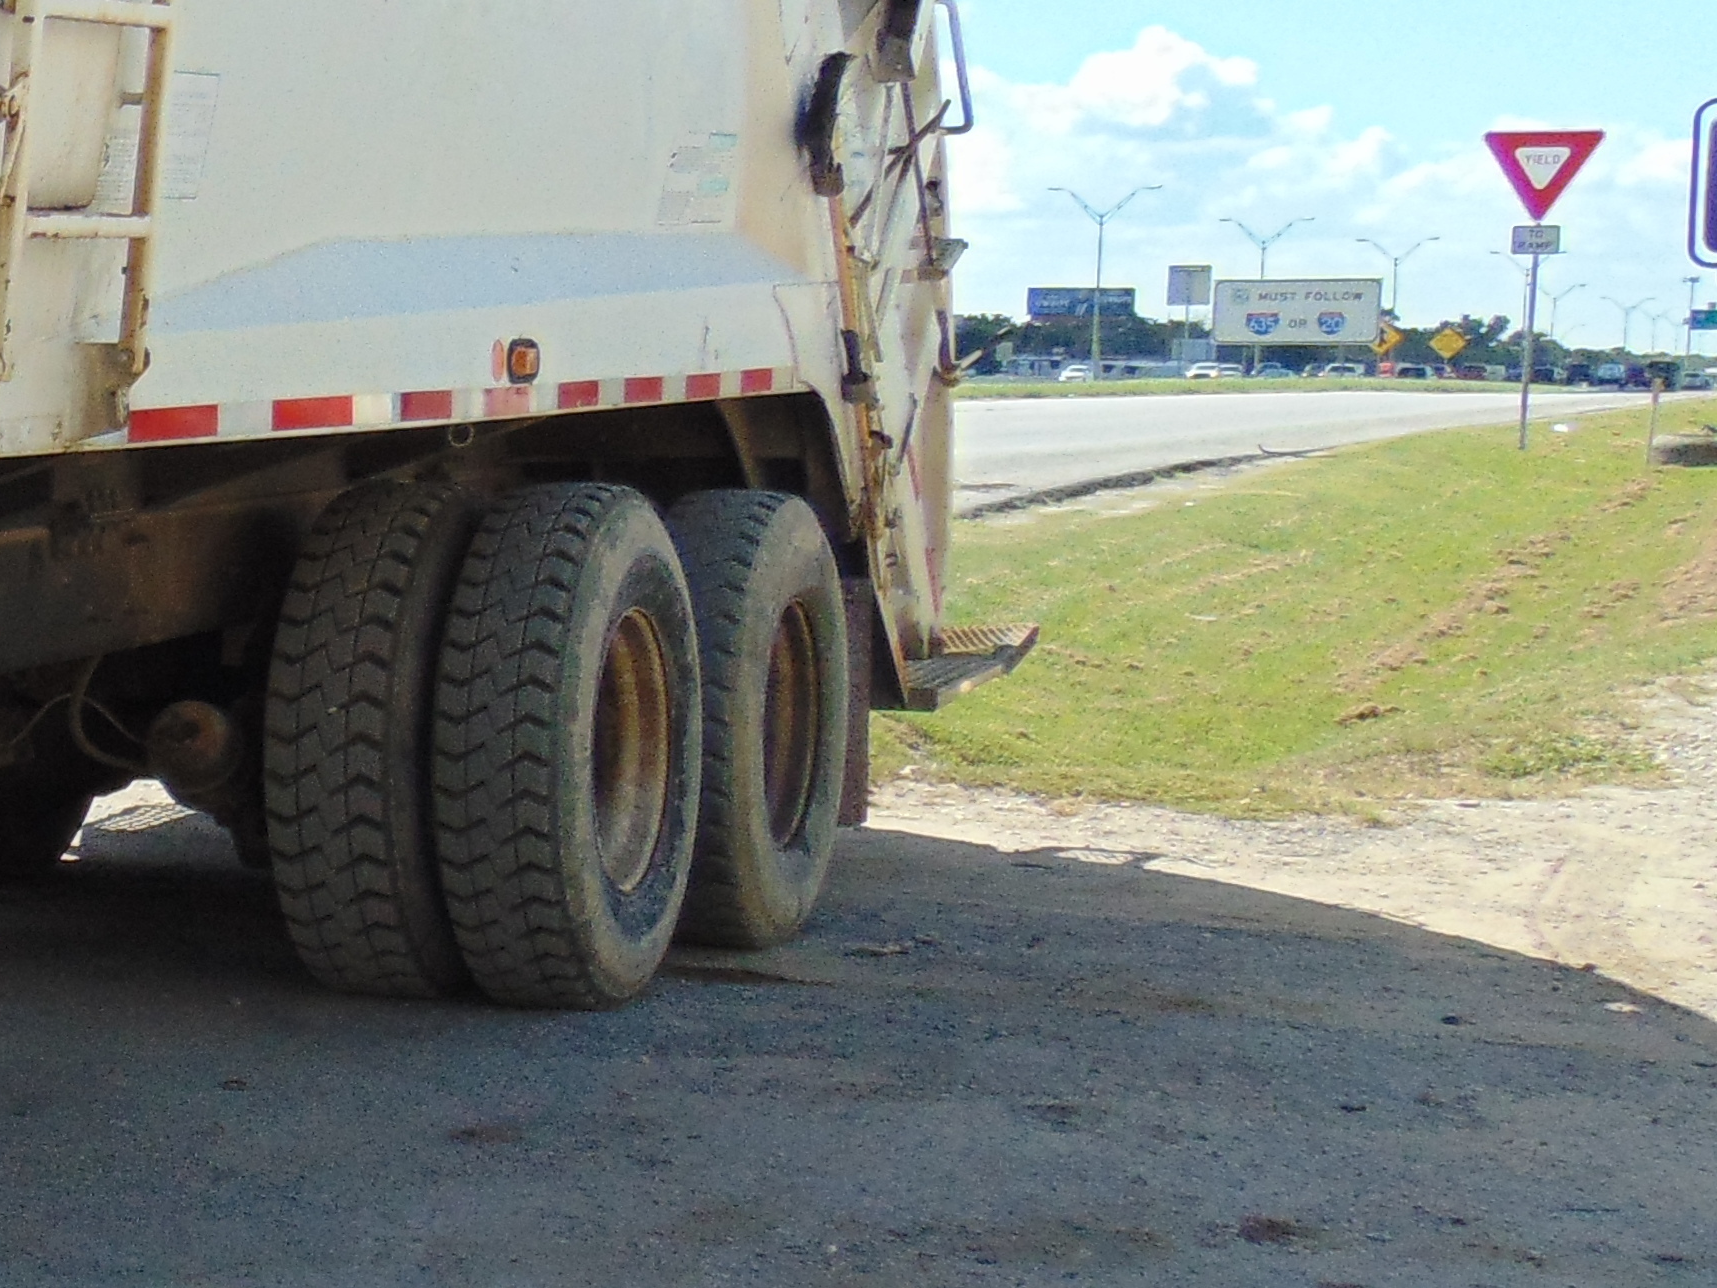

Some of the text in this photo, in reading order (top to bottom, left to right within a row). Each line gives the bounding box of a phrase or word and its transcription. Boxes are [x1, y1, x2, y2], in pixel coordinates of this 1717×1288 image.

[1525, 154, 1561, 165] YIELD
[1529, 229, 1544, 239] TO
[1258, 291, 1296, 302] MUST
[1304, 291, 1364, 302] FOLLOW
[1249, 317, 1343, 332] 635 OR 20
